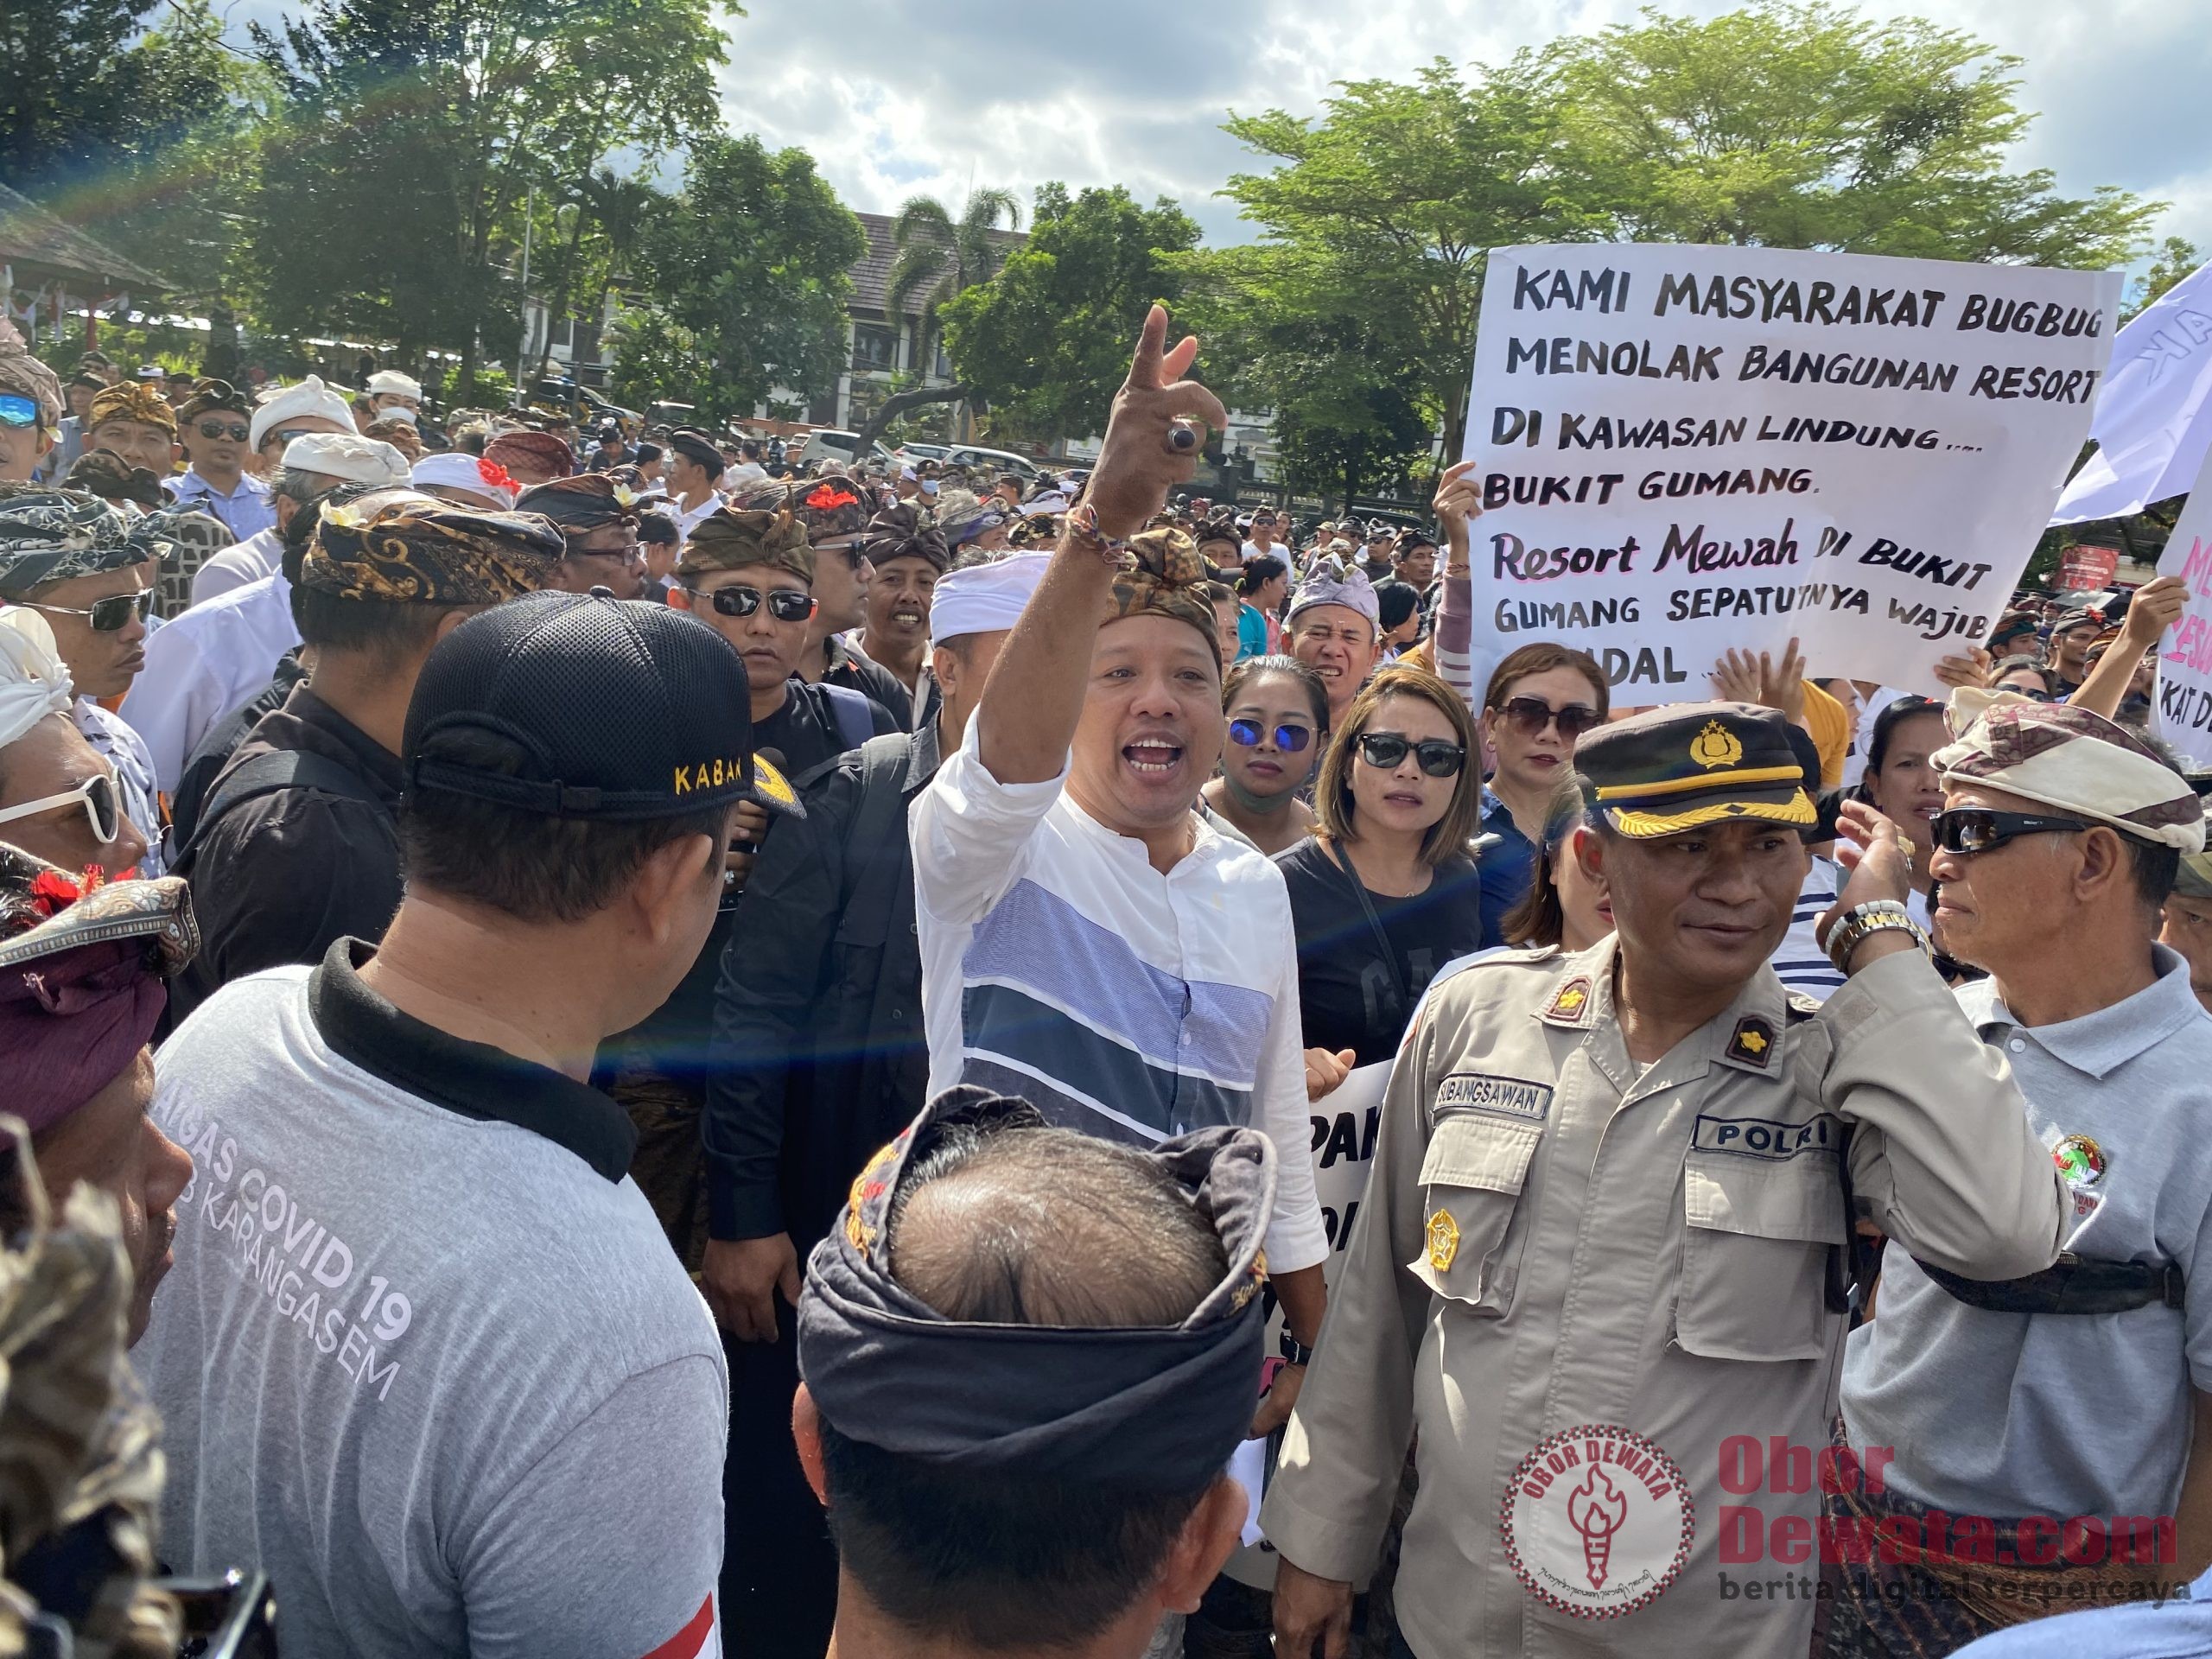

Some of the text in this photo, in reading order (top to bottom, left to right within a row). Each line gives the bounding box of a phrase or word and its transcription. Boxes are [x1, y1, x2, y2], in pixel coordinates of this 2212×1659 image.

[1513, 264, 2103, 338] KAMI MASYARAKAT BUGBUG
[1506, 337, 2102, 404] MENOLAK BANGUNAN RESORT
[1491, 406, 1542, 448] DI
[1557, 412, 1748, 450] KAWASAN
[1483, 473, 1624, 511] BUKIT
[1490, 517, 1993, 595] Resort Mewah DI BUKIT
[1495, 596, 1640, 632] GUMANG
[1666, 582, 1869, 622] SEPATUTNYA
[1717, 1119, 1827, 1154] POLRI
[239, 1167, 353, 1288] COVID
[359, 1275, 412, 1341] 19
[200, 1181, 401, 1402] KARANGASEM
